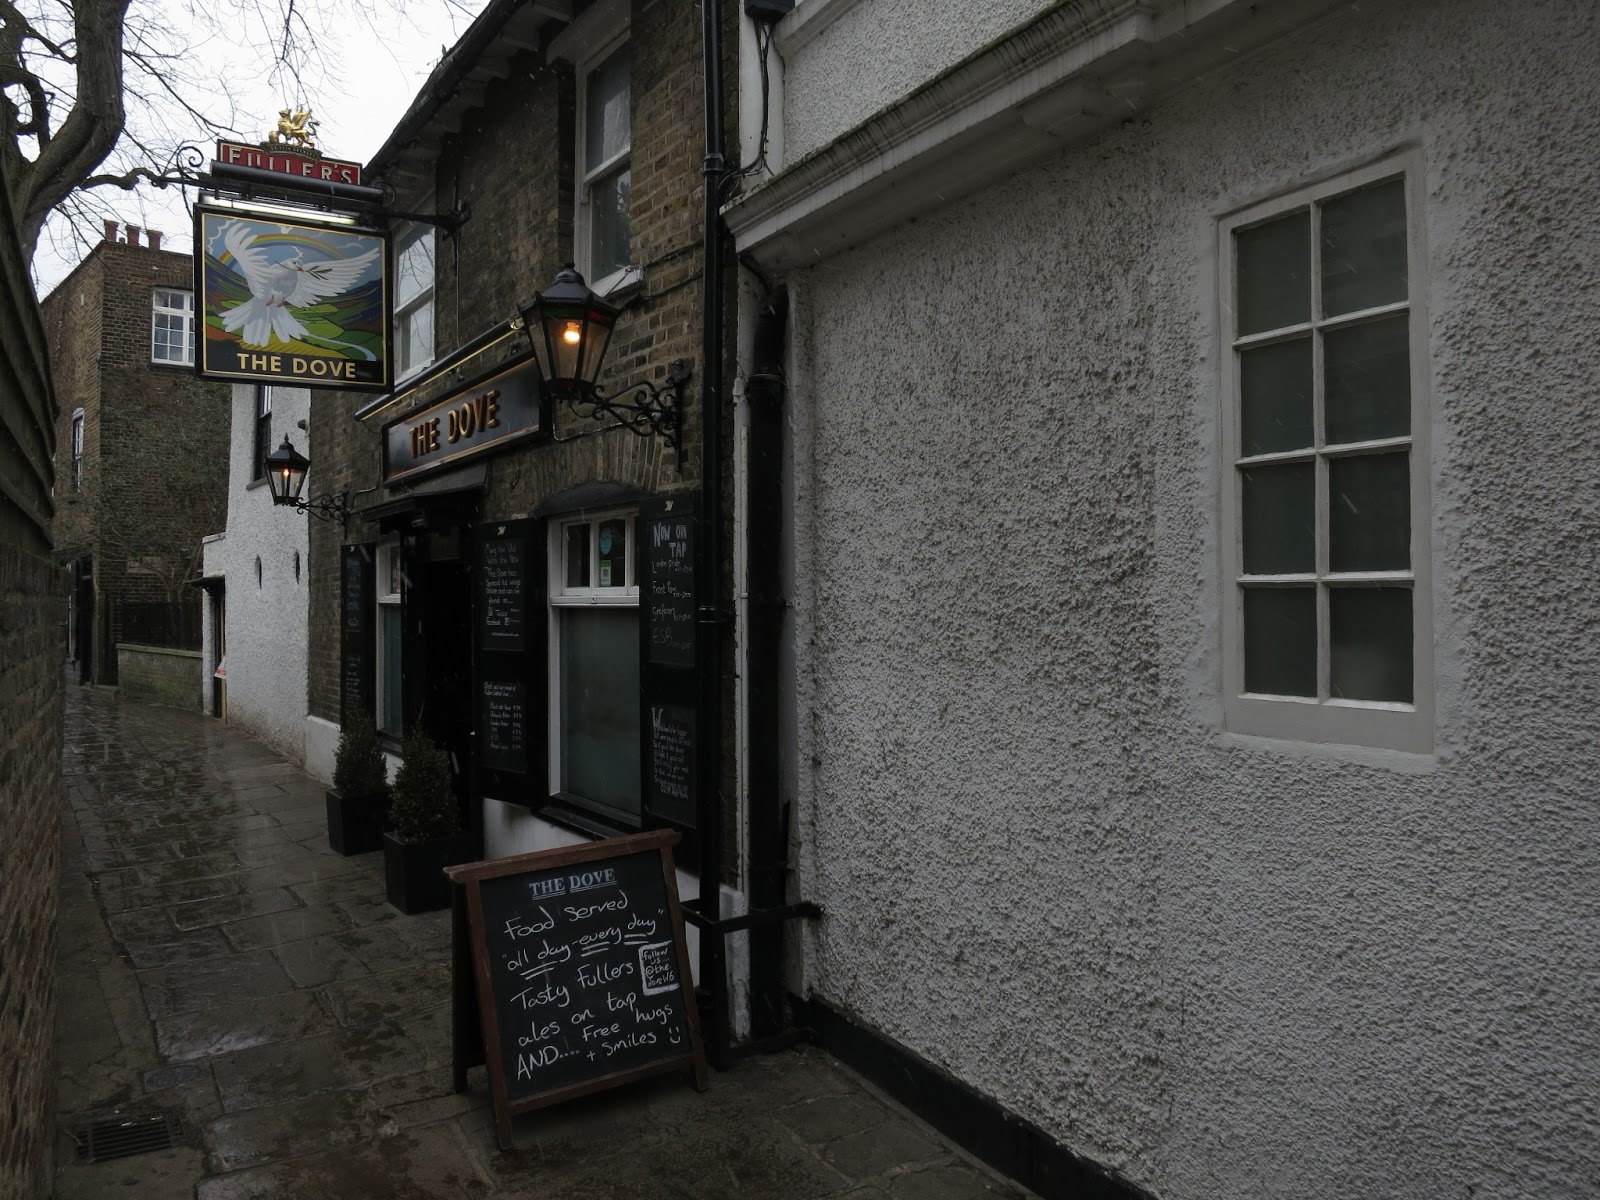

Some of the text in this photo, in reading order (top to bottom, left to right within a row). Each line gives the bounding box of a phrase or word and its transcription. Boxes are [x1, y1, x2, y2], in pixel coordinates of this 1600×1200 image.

[236, 352, 357, 379] THE DOVE
[409, 389, 500, 458] THE DOVE
[668, 542, 687, 558] TAP
[652, 626, 673, 647] ESB
[529, 868, 616, 899] THE DOVE
[504, 905, 554, 940] Food
[510, 961, 634, 1010] Tasty Fullers
[518, 991, 637, 1047] ales on tap
[582, 1022, 620, 1042] Free
[635, 1004, 673, 1025] hugs
